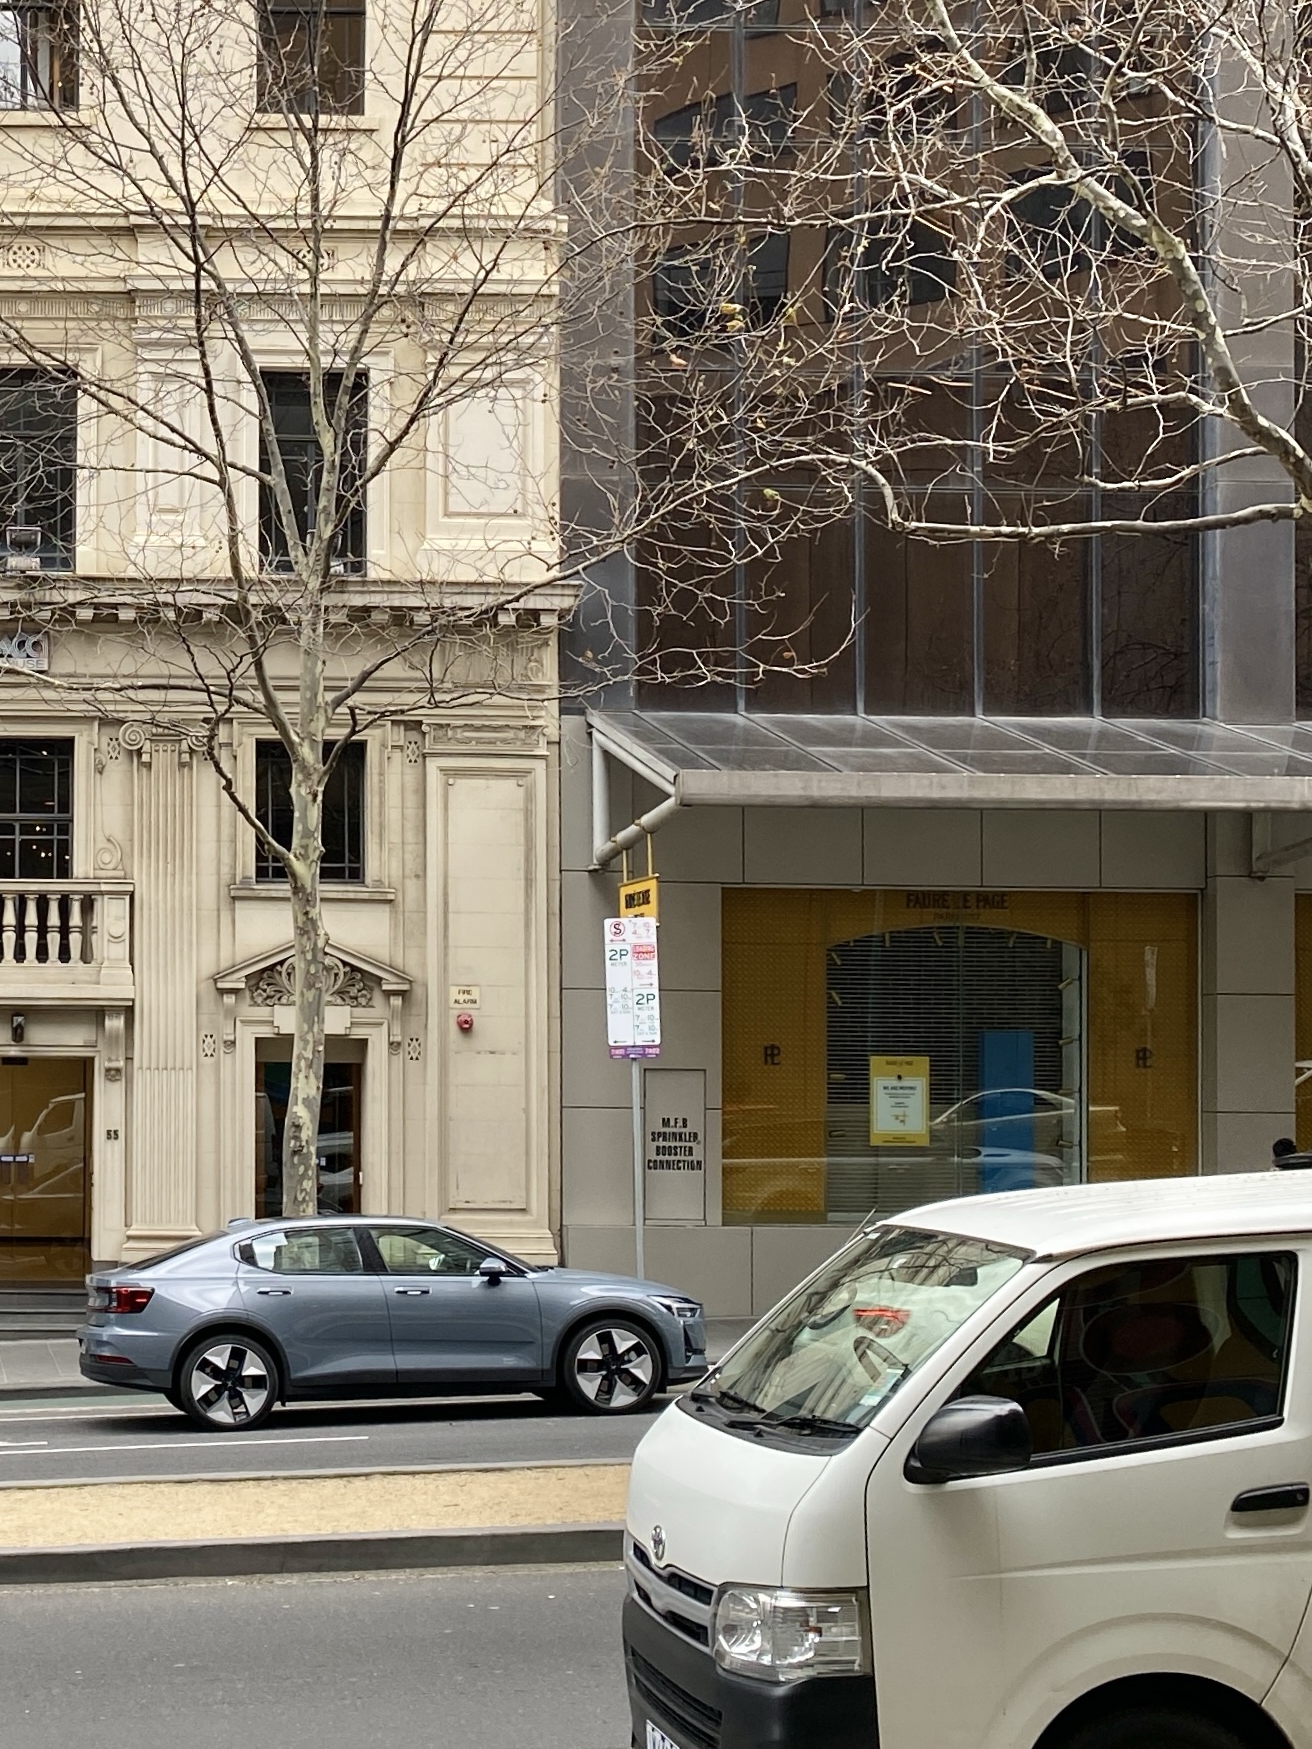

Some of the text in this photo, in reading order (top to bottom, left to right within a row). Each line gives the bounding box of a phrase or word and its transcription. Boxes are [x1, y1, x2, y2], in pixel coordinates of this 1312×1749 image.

[905, 892, 950, 909] FAURE
[975, 893, 1009, 910] PAGE
[608, 948, 629, 961] 2P
[636, 993, 656, 1005] 2P
[651, 1131, 699, 1143] SPRINKLER
[655, 1145, 693, 1157] BOOSTER
[647, 1159, 702, 1171] CONNECTION
